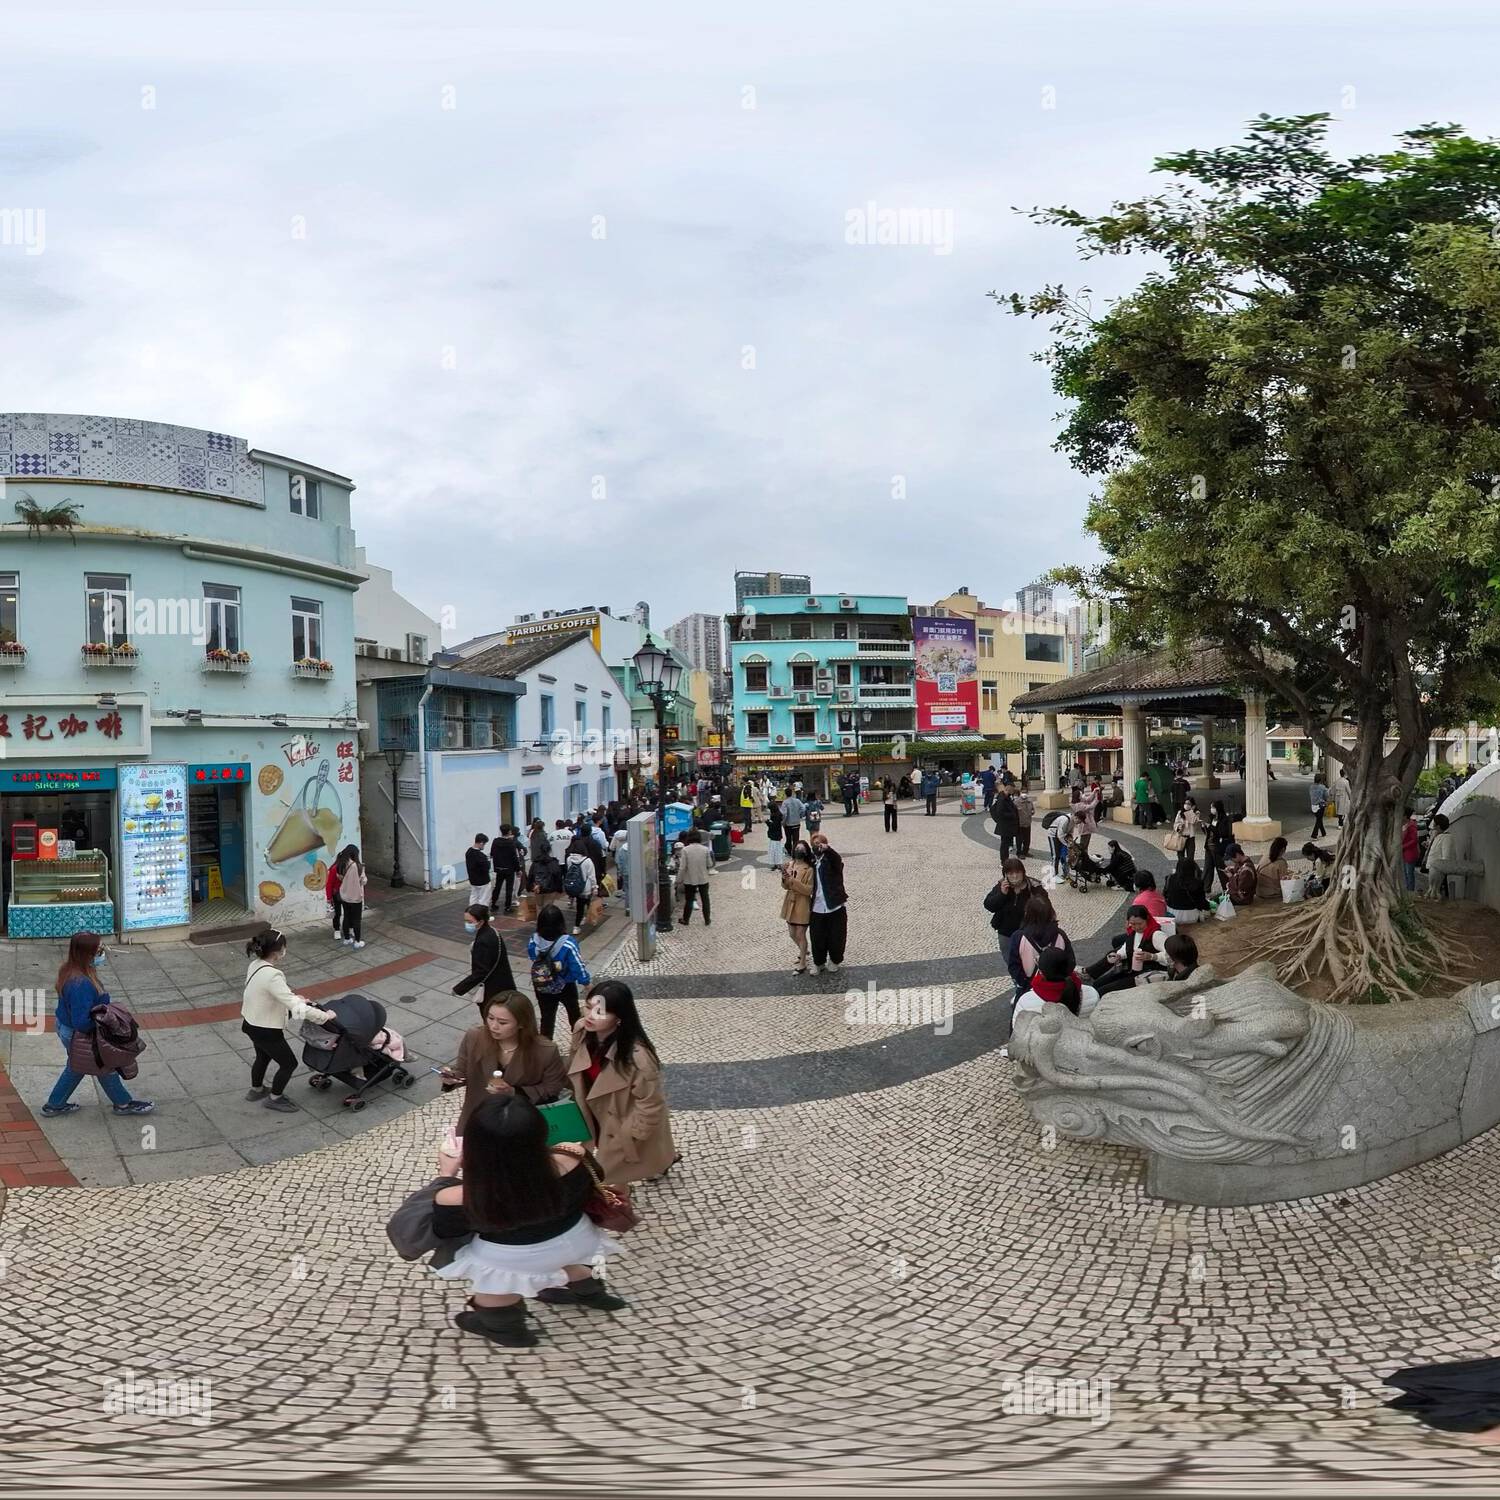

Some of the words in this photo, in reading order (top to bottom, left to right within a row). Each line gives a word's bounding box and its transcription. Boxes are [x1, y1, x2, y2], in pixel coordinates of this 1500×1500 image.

[507, 623, 559, 638] STARBUCKS
[560, 616, 598, 629] COFFEE
[337, 741, 354, 783] 旺記
[34, 781, 60, 789] SINCE
